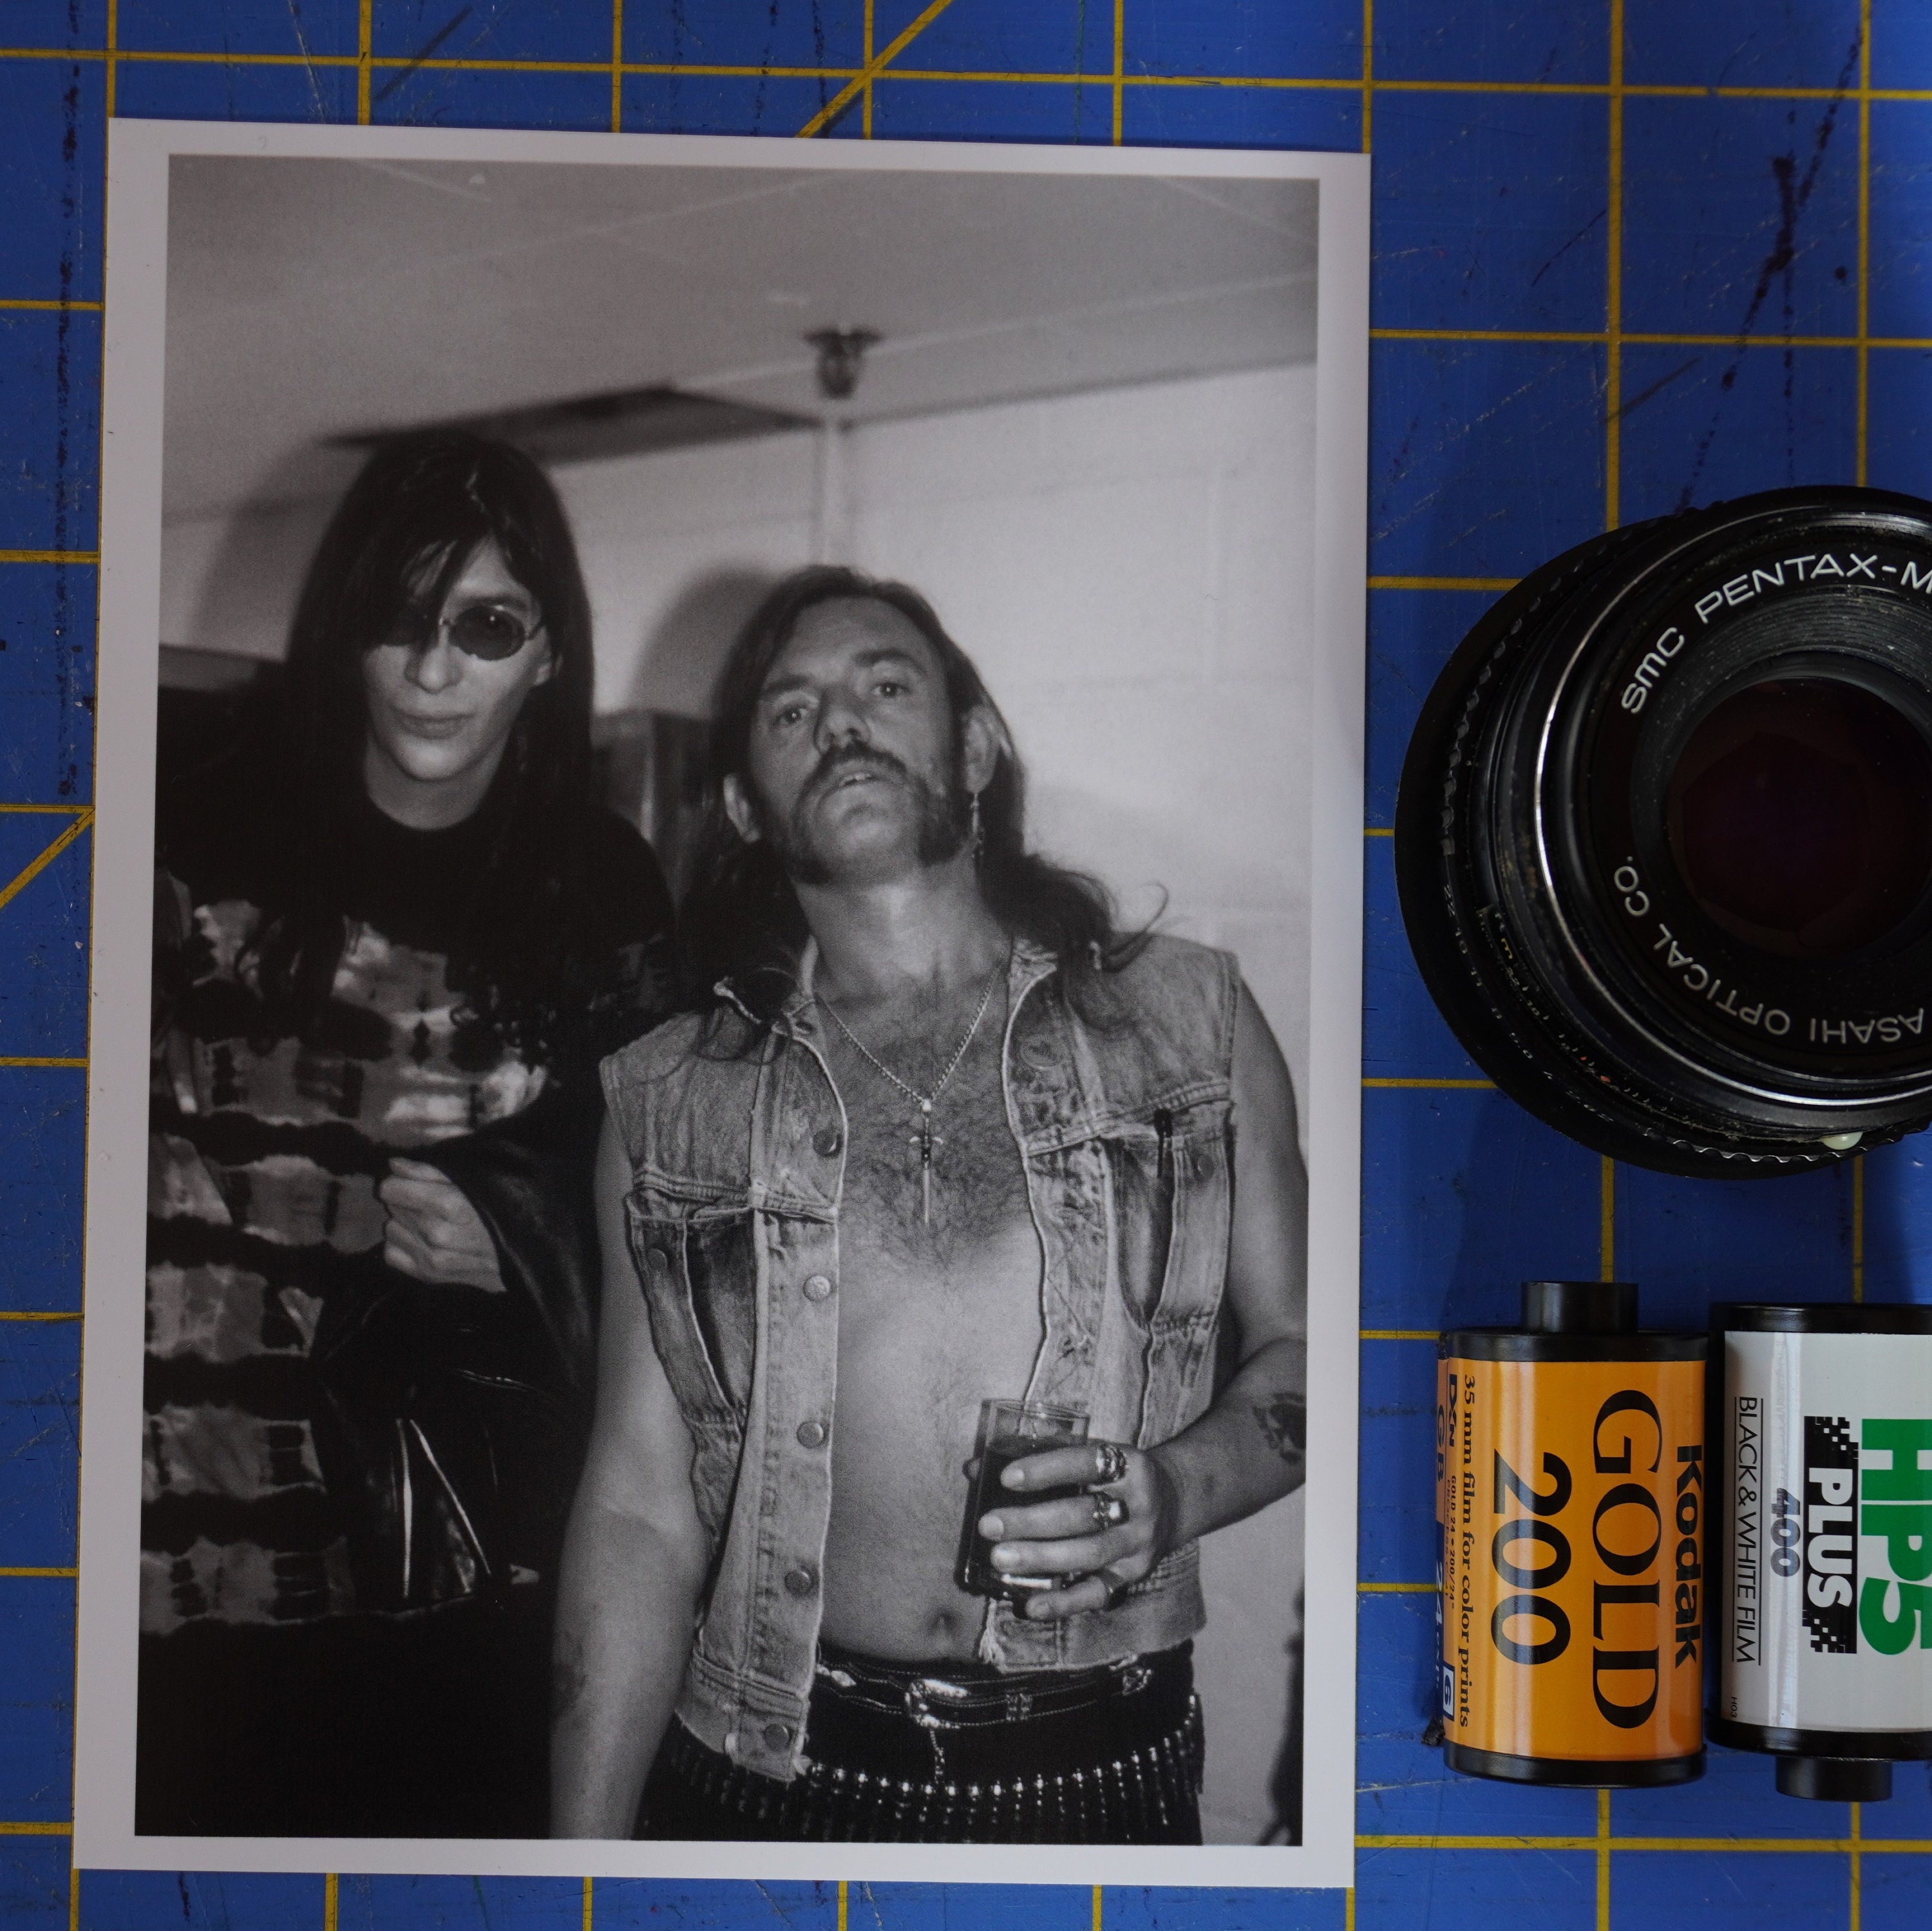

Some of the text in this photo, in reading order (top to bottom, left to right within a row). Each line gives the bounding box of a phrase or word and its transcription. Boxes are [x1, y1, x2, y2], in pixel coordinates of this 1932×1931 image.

[1613, 855, 1924, 1044] ASAHI OPTICAL CO.
[1738, 1397, 1758, 1483] BLACK
[1450, 1516, 1456, 1532] 24
[1458, 1374, 1475, 1728] 35 mm film for color prints
[1491, 1449, 1572, 1665] 200
[1593, 1389, 1662, 1729] GOLD
[1676, 1444, 1702, 1669] Kodak
[1737, 1511, 1757, 1599] WHITE
[1770, 1487, 1801, 1578] 400
[1807, 1467, 1853, 1608] PLUS
[1859, 1418, 1932, 1655] HP5
[1444, 1675, 1452, 1706] 6
[1736, 1606, 1757, 1663] FILM
